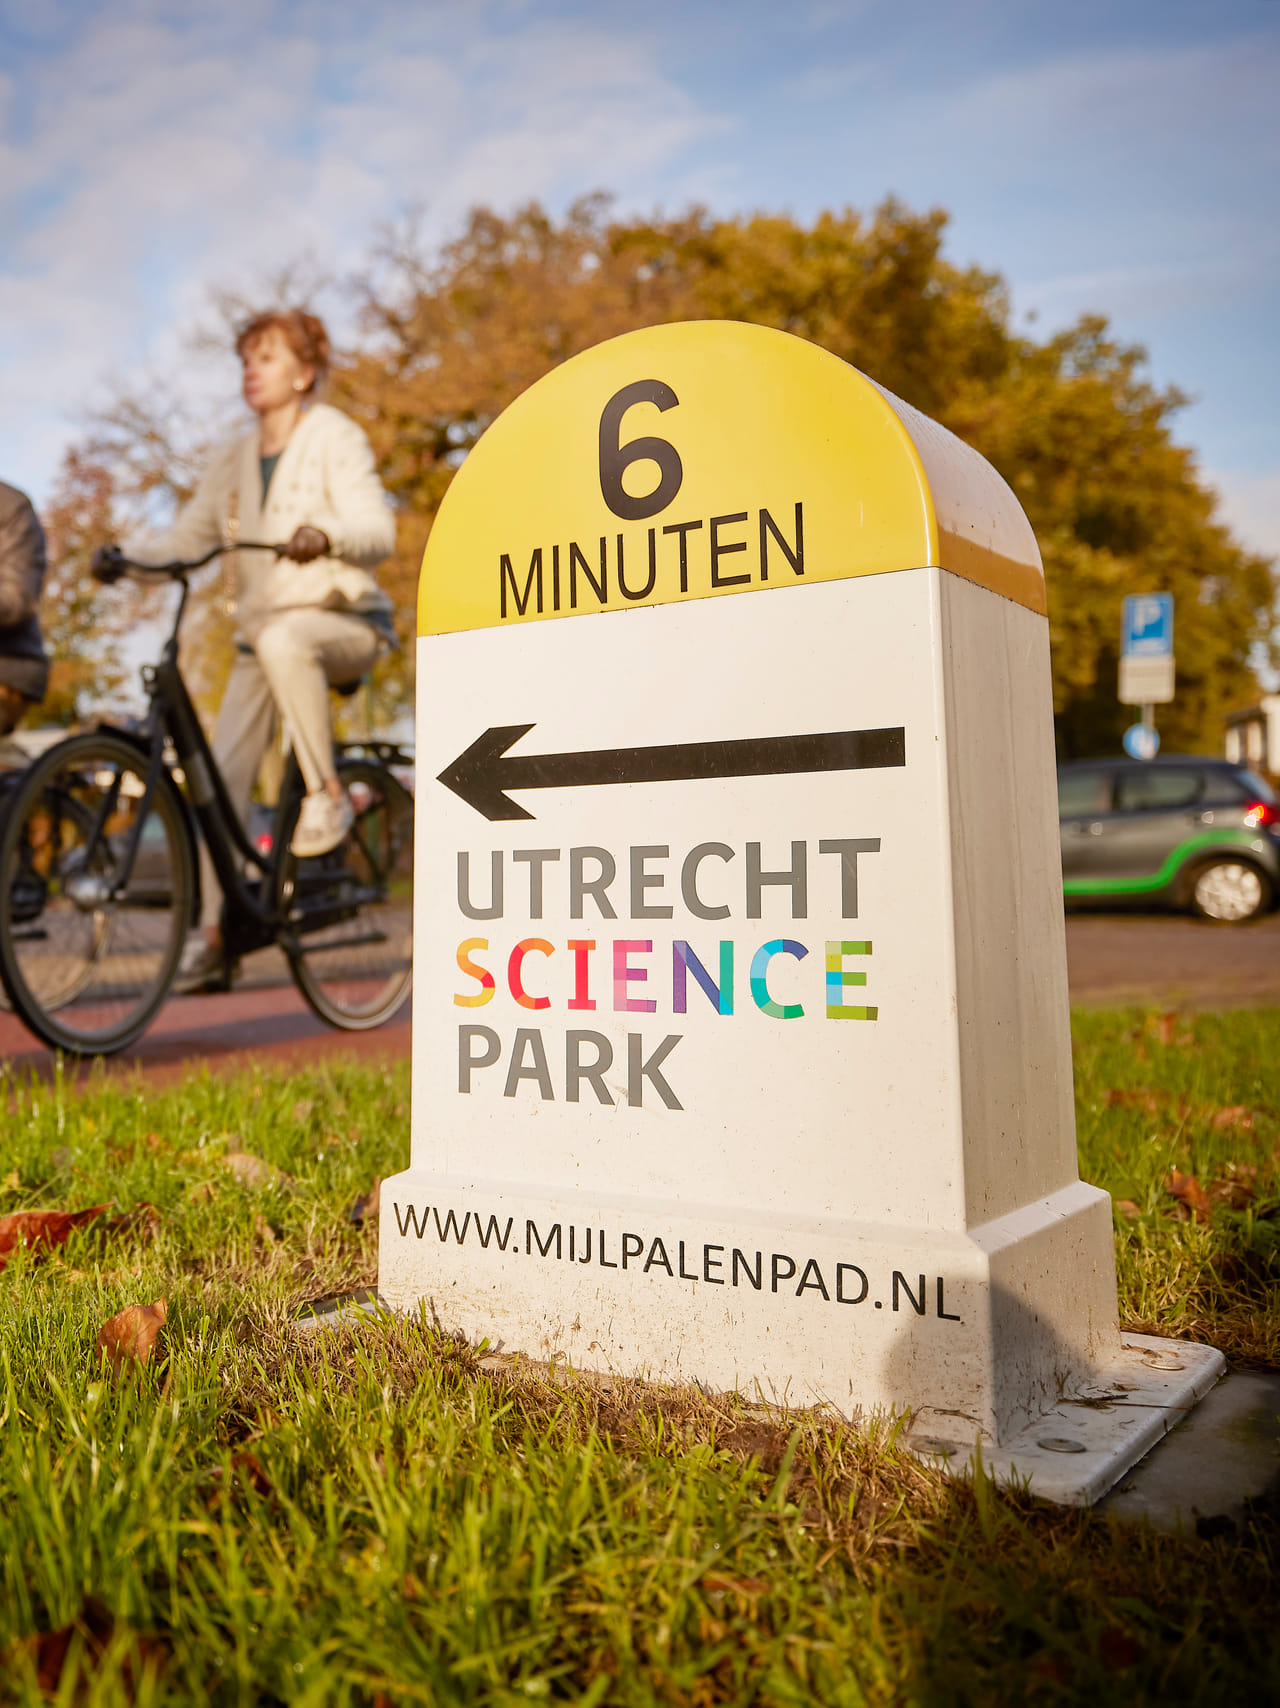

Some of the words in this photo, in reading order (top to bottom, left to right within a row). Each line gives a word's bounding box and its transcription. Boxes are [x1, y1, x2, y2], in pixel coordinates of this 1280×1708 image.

[598, 379, 684, 520] 6
[499, 502, 805, 618] MINUTEN
[457, 838, 881, 919] UTRECHT
[453, 938, 879, 1021] SCIENCE
[456, 1024, 685, 1111] PARK
[393, 1203, 962, 1321] WWW.MIJLPALENPAD.NL
